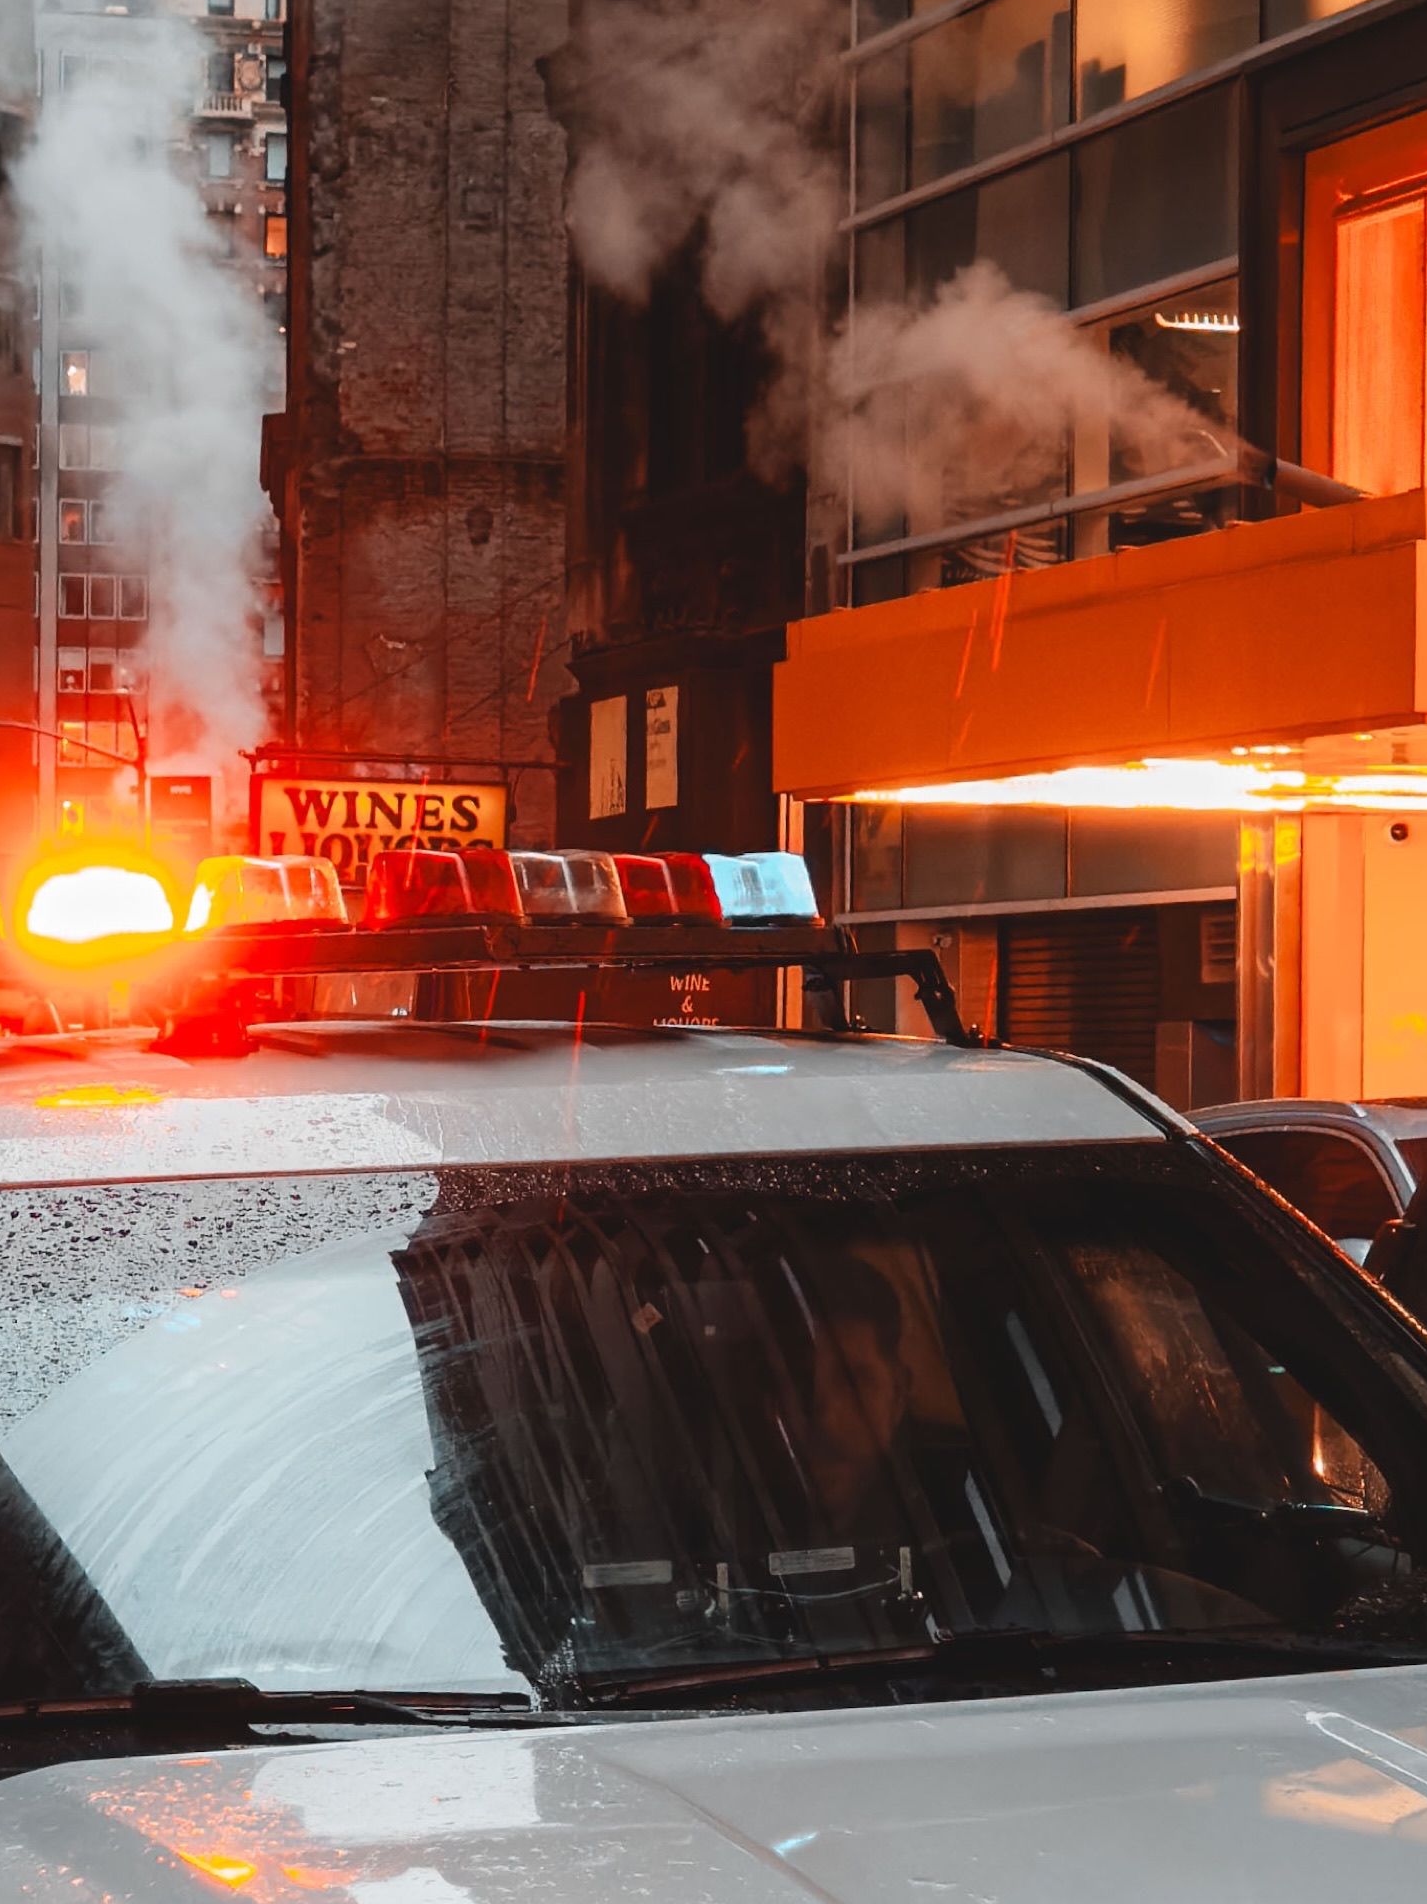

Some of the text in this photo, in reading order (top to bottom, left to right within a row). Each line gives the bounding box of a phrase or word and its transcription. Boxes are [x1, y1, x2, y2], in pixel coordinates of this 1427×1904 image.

[283, 787, 481, 833] WINES
[670, 973, 711, 992] WINE
[681, 994, 694, 1013] &
